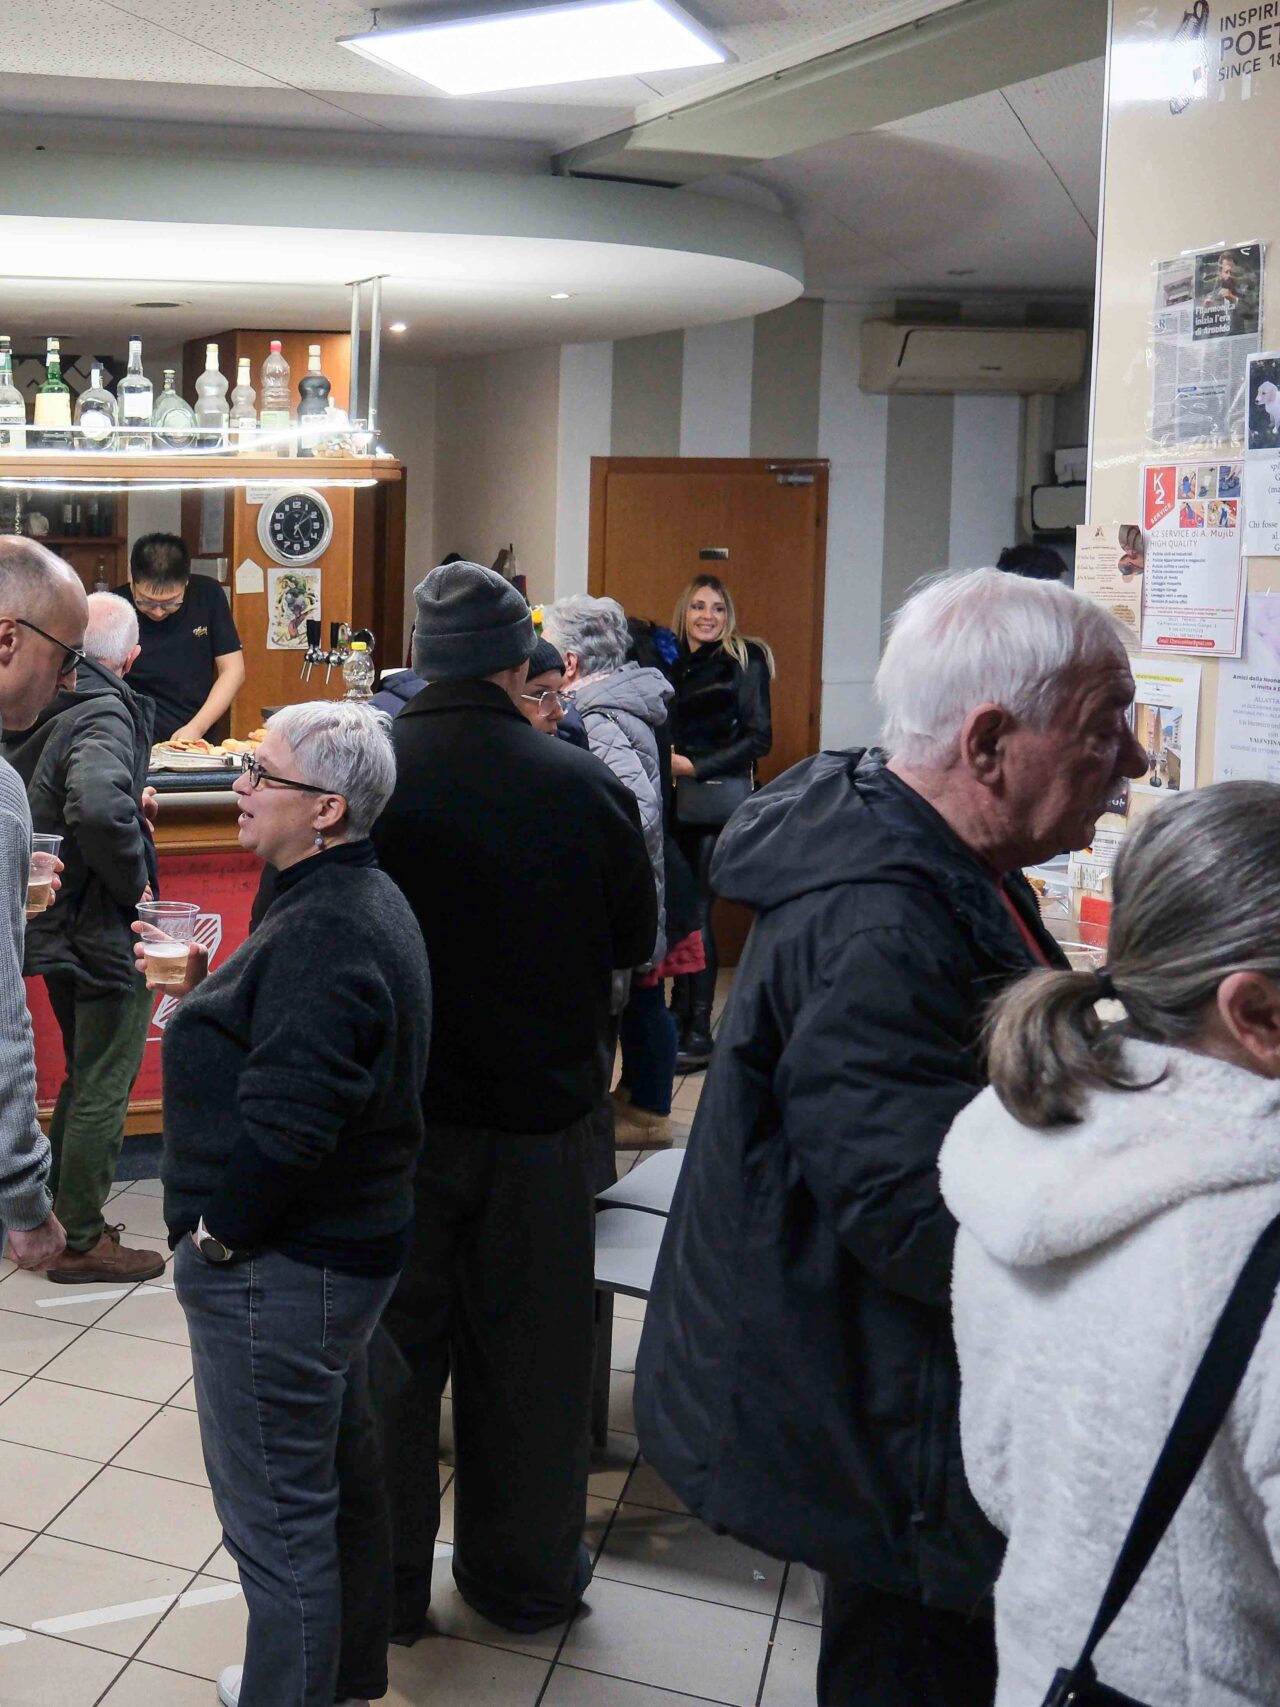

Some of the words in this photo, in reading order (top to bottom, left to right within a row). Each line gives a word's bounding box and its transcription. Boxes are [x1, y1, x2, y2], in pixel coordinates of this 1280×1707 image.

[1218, 58, 1260, 81] SINCE
[292, 501, 301, 509] 12
[1150, 502, 1172, 524] SERVICE
[1249, 520, 1260, 528] Chi
[1262, 520, 1278, 528] fosse
[1210, 530, 1234, 539] Mujib
[1168, 540, 1198, 549] QUALITY
